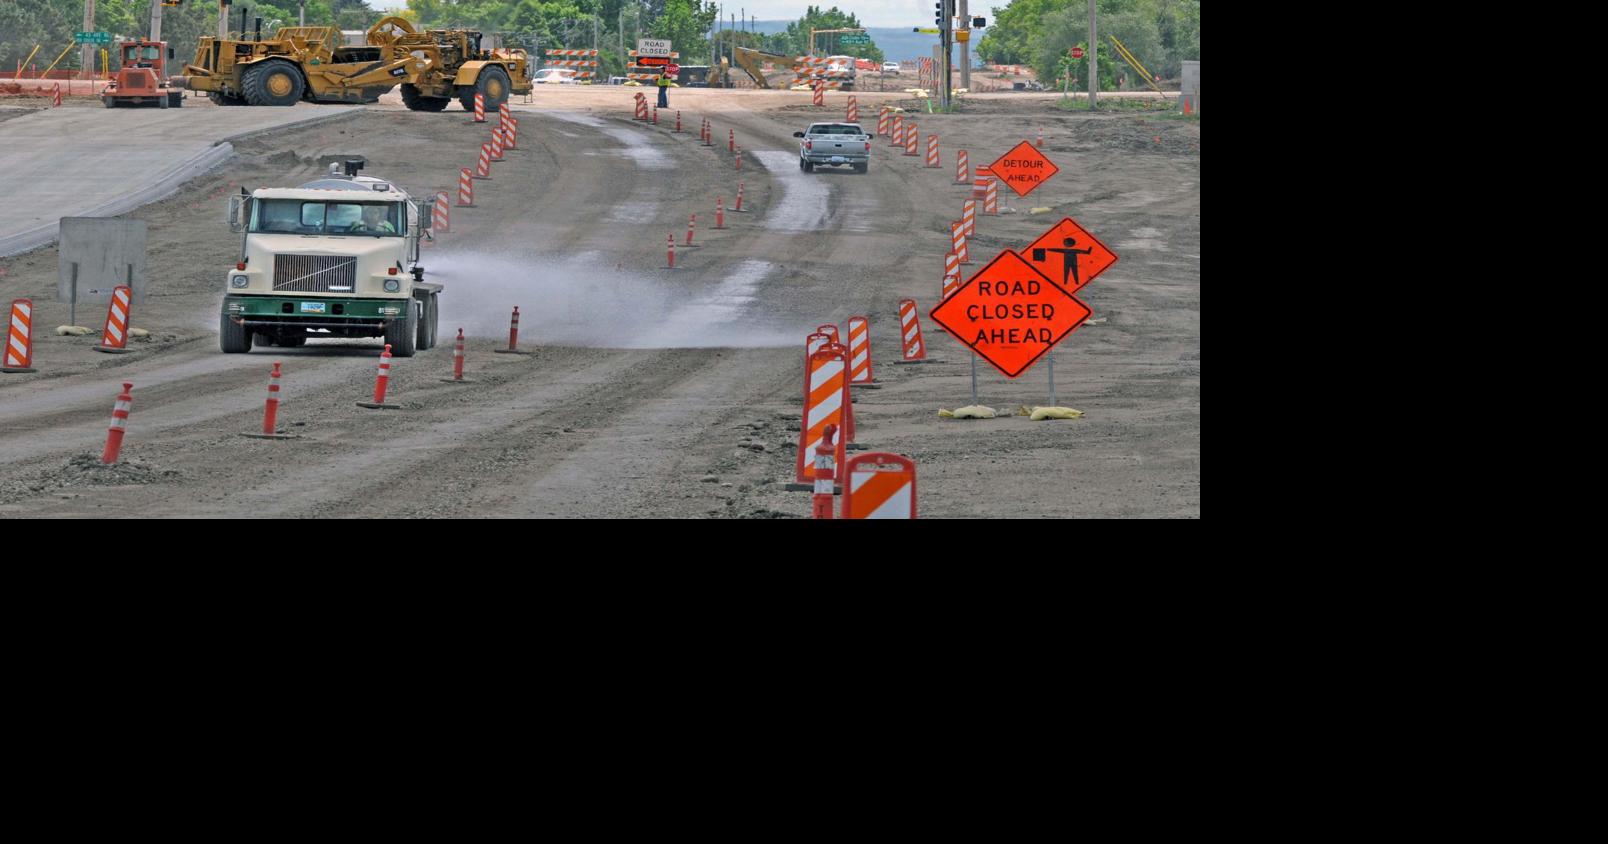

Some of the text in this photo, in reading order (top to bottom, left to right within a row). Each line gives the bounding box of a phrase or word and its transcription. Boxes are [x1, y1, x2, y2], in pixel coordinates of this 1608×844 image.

[1003, 160, 1044, 169] DETOUR
[1007, 174, 1040, 182] AHEAD
[979, 281, 1041, 296] ROAD
[966, 304, 1055, 320] CLOSED
[974, 328, 1052, 344] AHEAD
